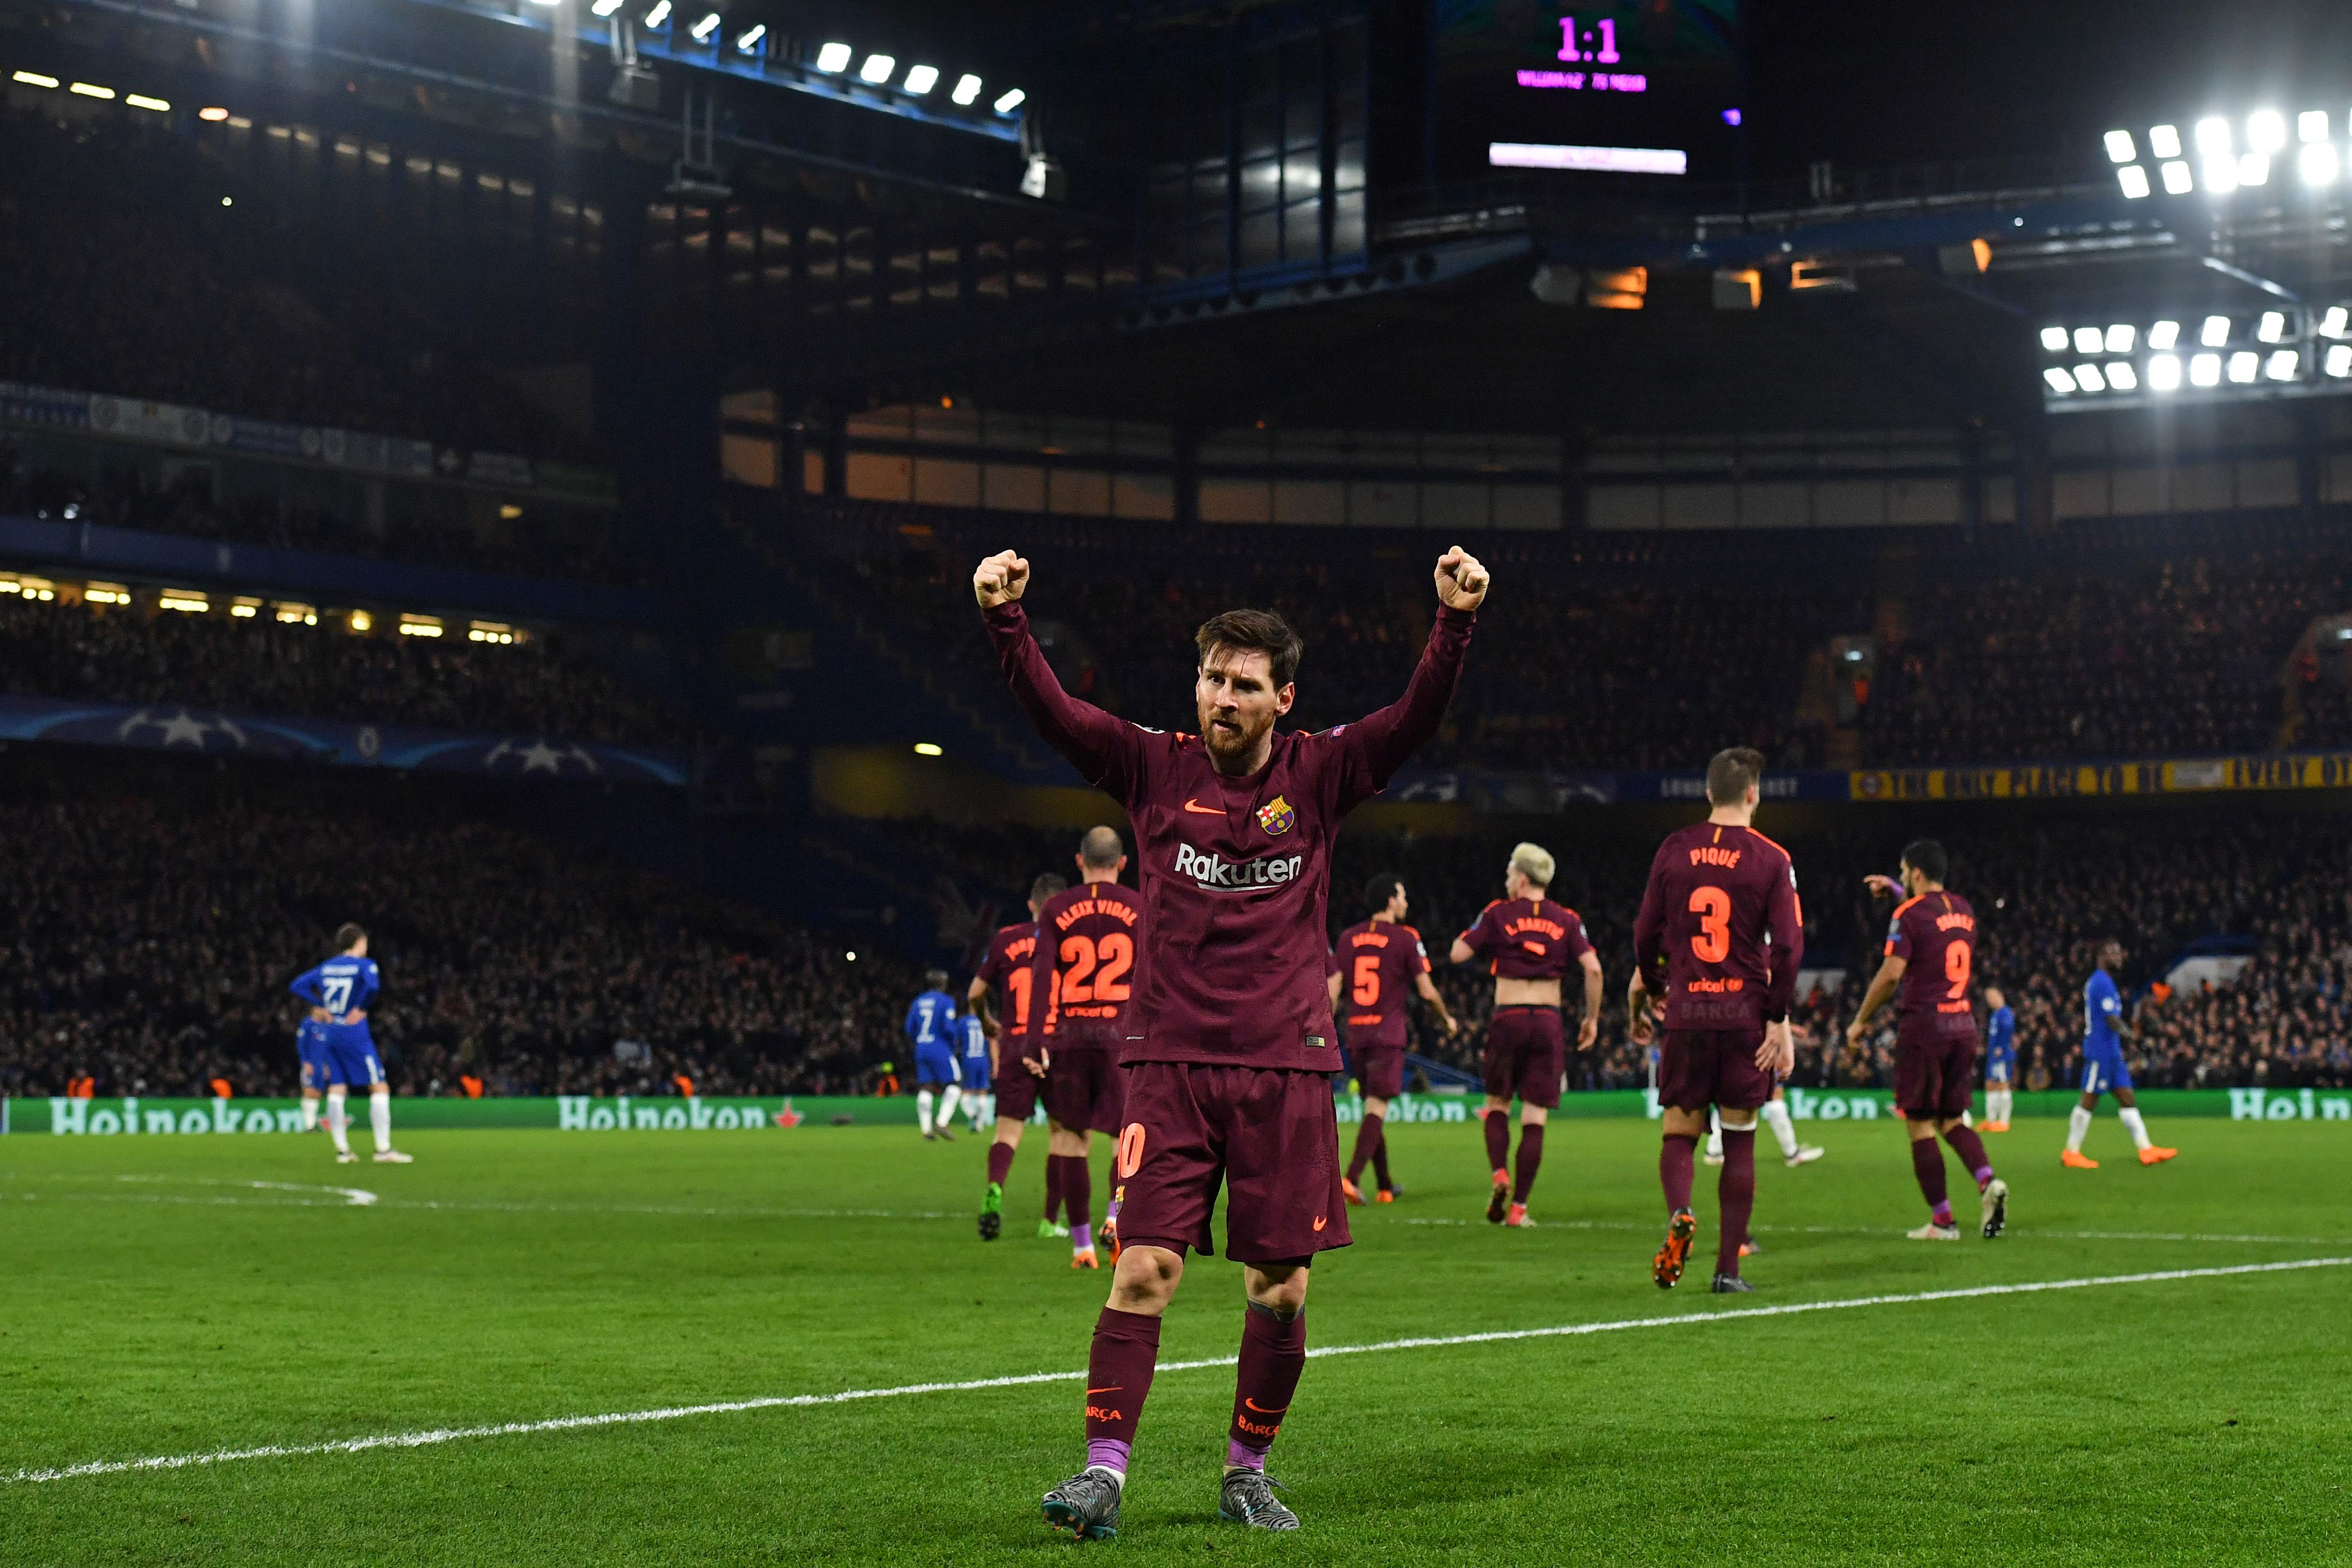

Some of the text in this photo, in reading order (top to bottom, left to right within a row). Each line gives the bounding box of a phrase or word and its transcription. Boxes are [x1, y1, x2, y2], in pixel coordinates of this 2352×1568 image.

[1557, 16, 1620, 64] 1:1
[1174, 843, 1302, 885] Rakuten
[1690, 847, 1741, 869] PIQUÉ
[1689, 886, 1731, 963] 3
[1060, 932, 1134, 1003] 22
[1352, 955, 1380, 1006] 5
[1945, 939, 1971, 1000] 9
[323, 977, 353, 1014] 27
[557, 1096, 765, 1131] Heineken
[1118, 1123, 1146, 1180] 0
[1086, 1406, 1122, 1422] ARÇA
[1238, 1414, 1280, 1438] BARÇA
